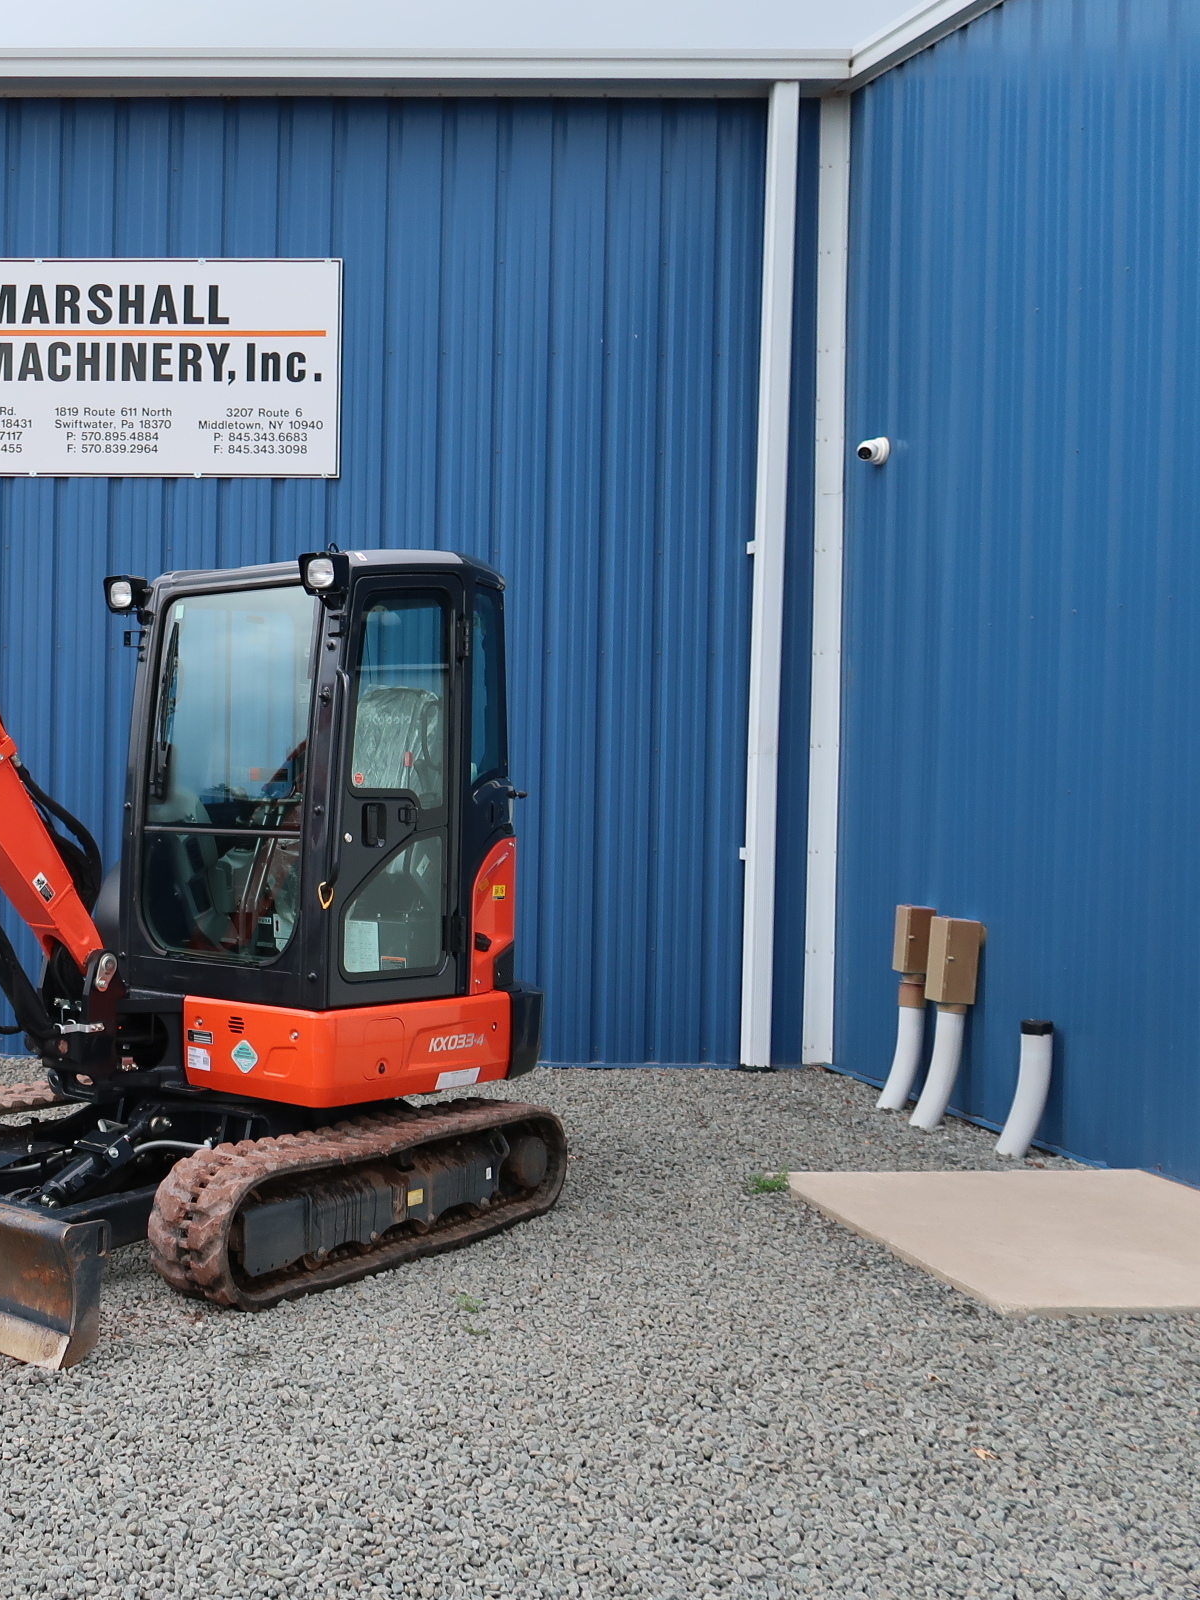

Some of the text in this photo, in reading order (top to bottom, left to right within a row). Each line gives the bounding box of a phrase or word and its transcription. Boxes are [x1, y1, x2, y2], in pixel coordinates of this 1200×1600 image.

[247, 343, 321, 382] Inc.
[0, 406, 17, 416] Rd.
[54, 406, 172, 417] 1819 Route 611 North
[226, 407, 303, 418] 3207 Route 6
[1, 418, 32, 429] 18431
[54, 418, 172, 430] Swiftwater, Pa 18370
[198, 420, 324, 431] Middletown, NY 10940
[66, 431, 159, 442] P: 570.895.4884
[213, 432, 308, 442] P: 845.343.6683
[66, 443, 159, 454] F: 570.839.2964
[213, 444, 308, 455] F: 845.343.3098
